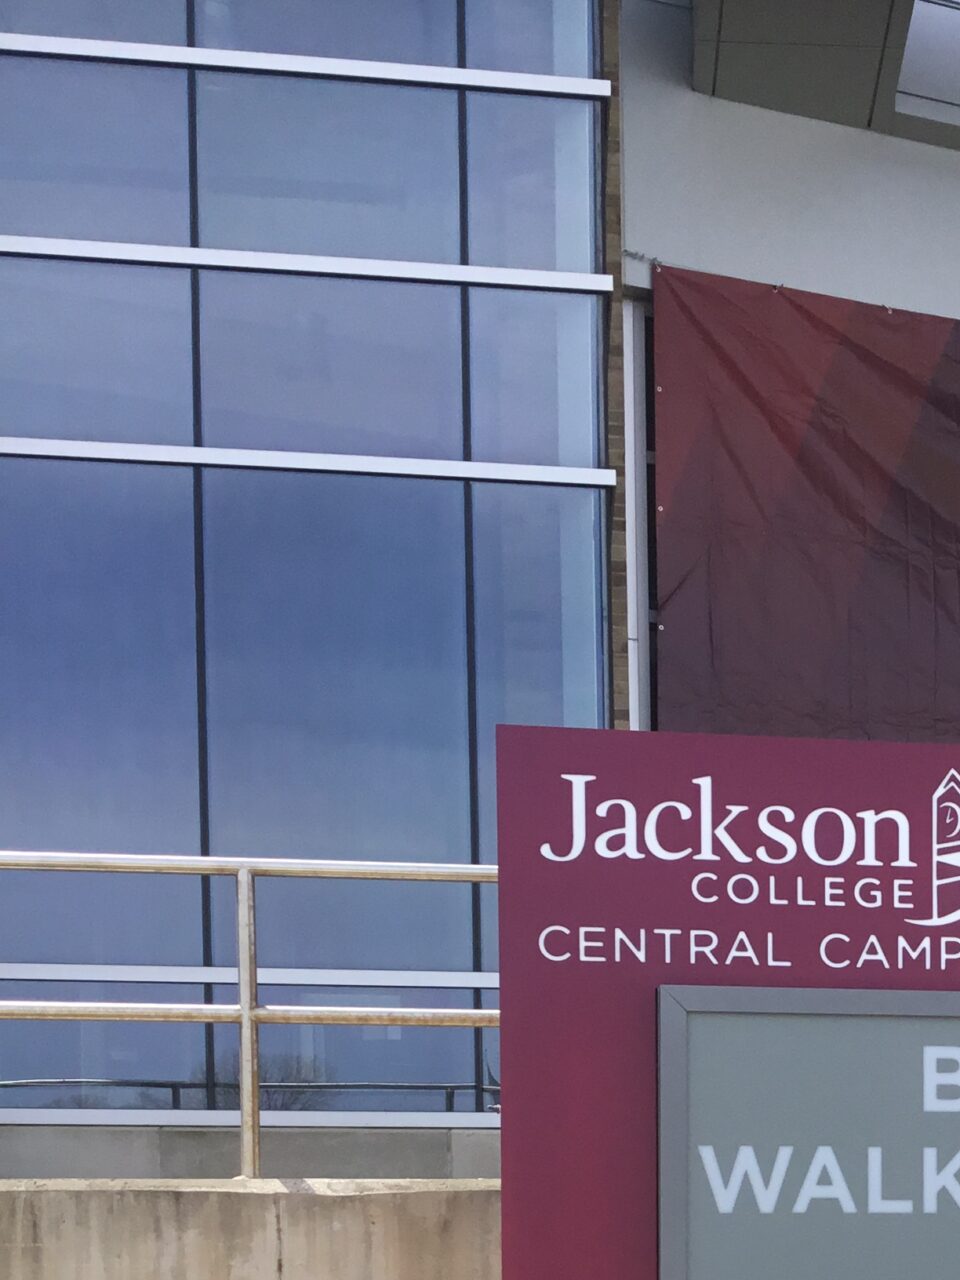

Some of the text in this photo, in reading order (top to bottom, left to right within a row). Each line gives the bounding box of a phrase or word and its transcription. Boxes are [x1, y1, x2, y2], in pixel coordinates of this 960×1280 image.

[539, 774, 918, 867] Jackson
[691, 872, 914, 909] COLLEGE
[538, 925, 792, 967] CENTRAL
